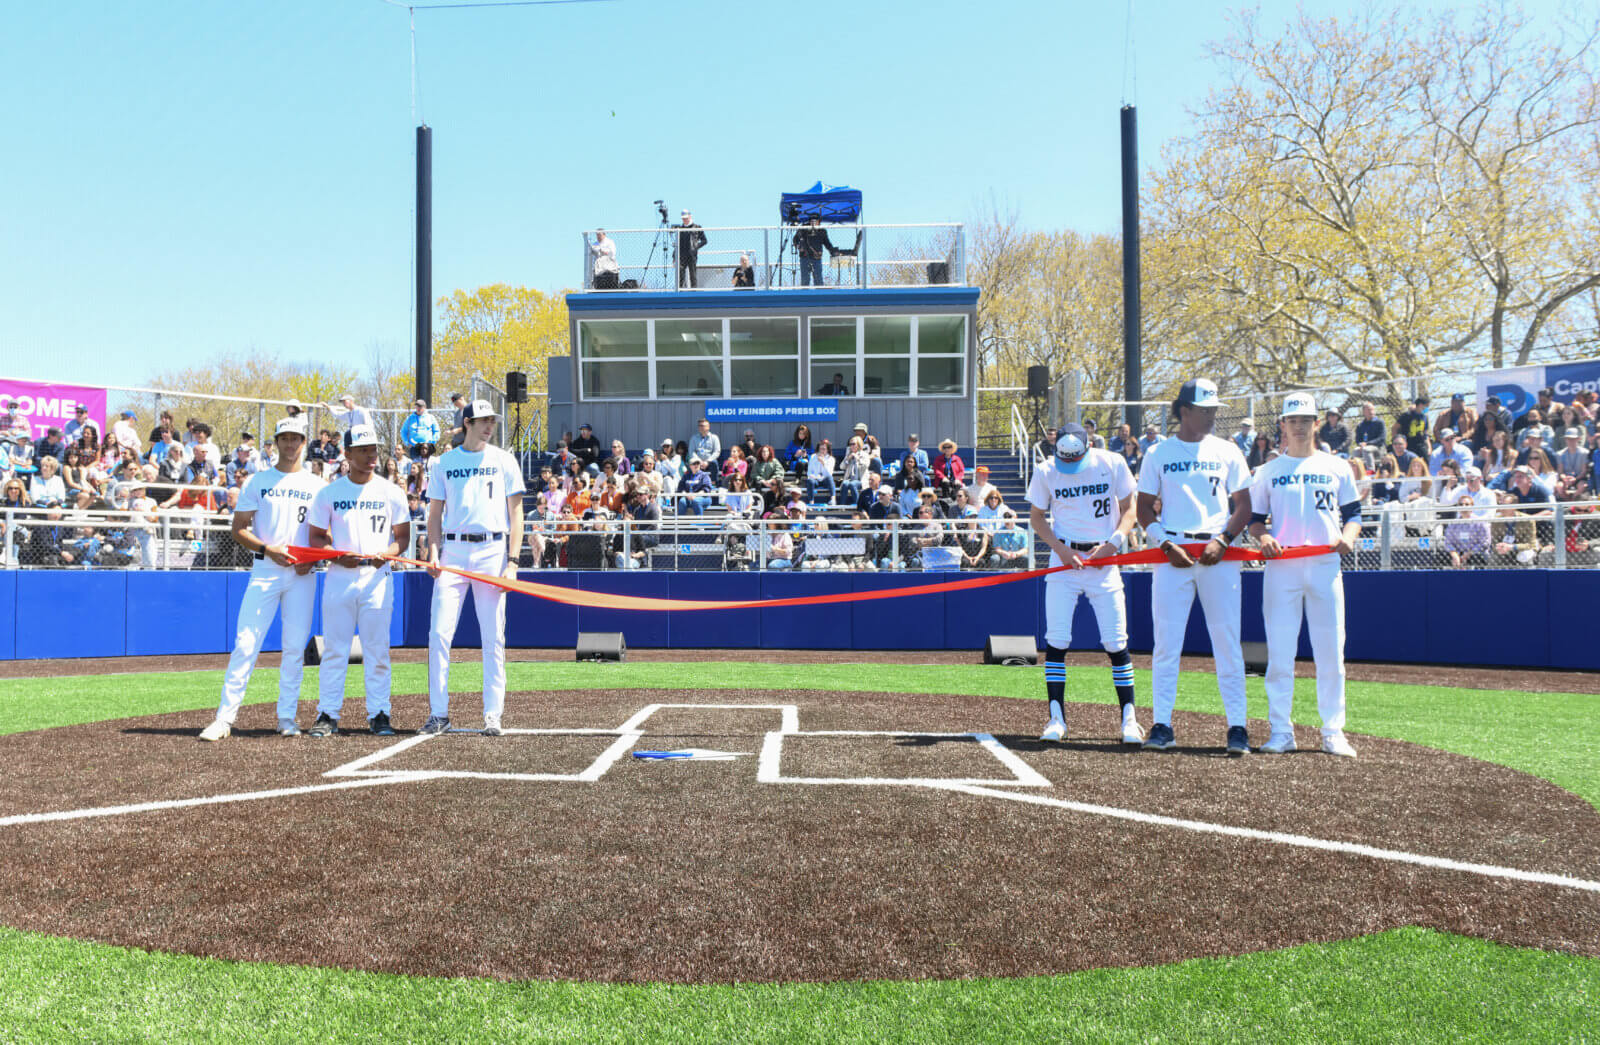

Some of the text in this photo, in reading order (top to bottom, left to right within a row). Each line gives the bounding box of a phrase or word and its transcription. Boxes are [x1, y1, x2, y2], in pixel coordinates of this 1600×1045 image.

[707, 407, 837, 416] SANDI FEINBERG PRESS BOX
[446, 467, 498, 480] POLY PREP
[1163, 461, 1221, 474] POLY PREP
[1209, 476, 1220, 496] 7
[1272, 474, 1333, 488] POLY PREP
[261, 488, 313, 501] POLY PREP
[486, 481, 494, 499] 1
[1055, 483, 1109, 499] POLY PREP
[333, 501, 385, 511] POLY PREP
[1092, 497, 1111, 518] 26
[297, 505, 308, 523] 8
[370, 514, 387, 533] 17
